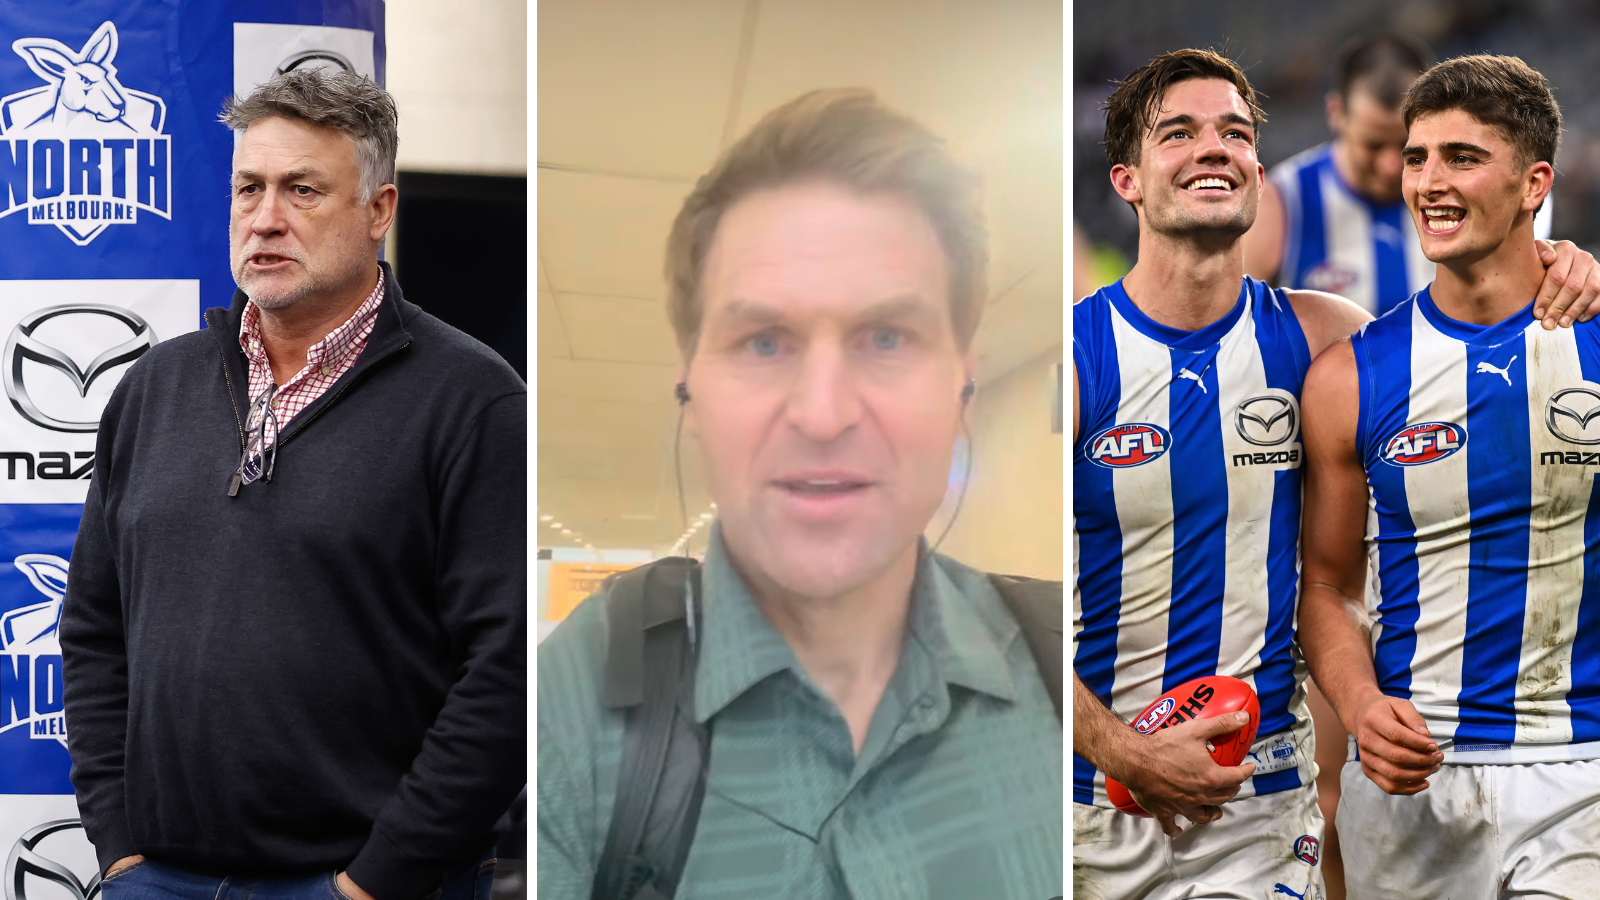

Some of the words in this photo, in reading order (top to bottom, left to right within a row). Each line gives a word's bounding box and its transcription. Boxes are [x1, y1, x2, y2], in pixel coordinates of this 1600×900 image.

[0, 138, 168, 215] NORTH
[32, 200, 133, 220] MELBOURNE
[1092, 431, 1165, 459] AFL
[1385, 428, 1460, 459] AFL
[1540, 451, 1600, 466] maz
[1137, 699, 1169, 731] AFL
[1151, 683, 1215, 735] SHE
[34, 717, 66, 735] MEL
